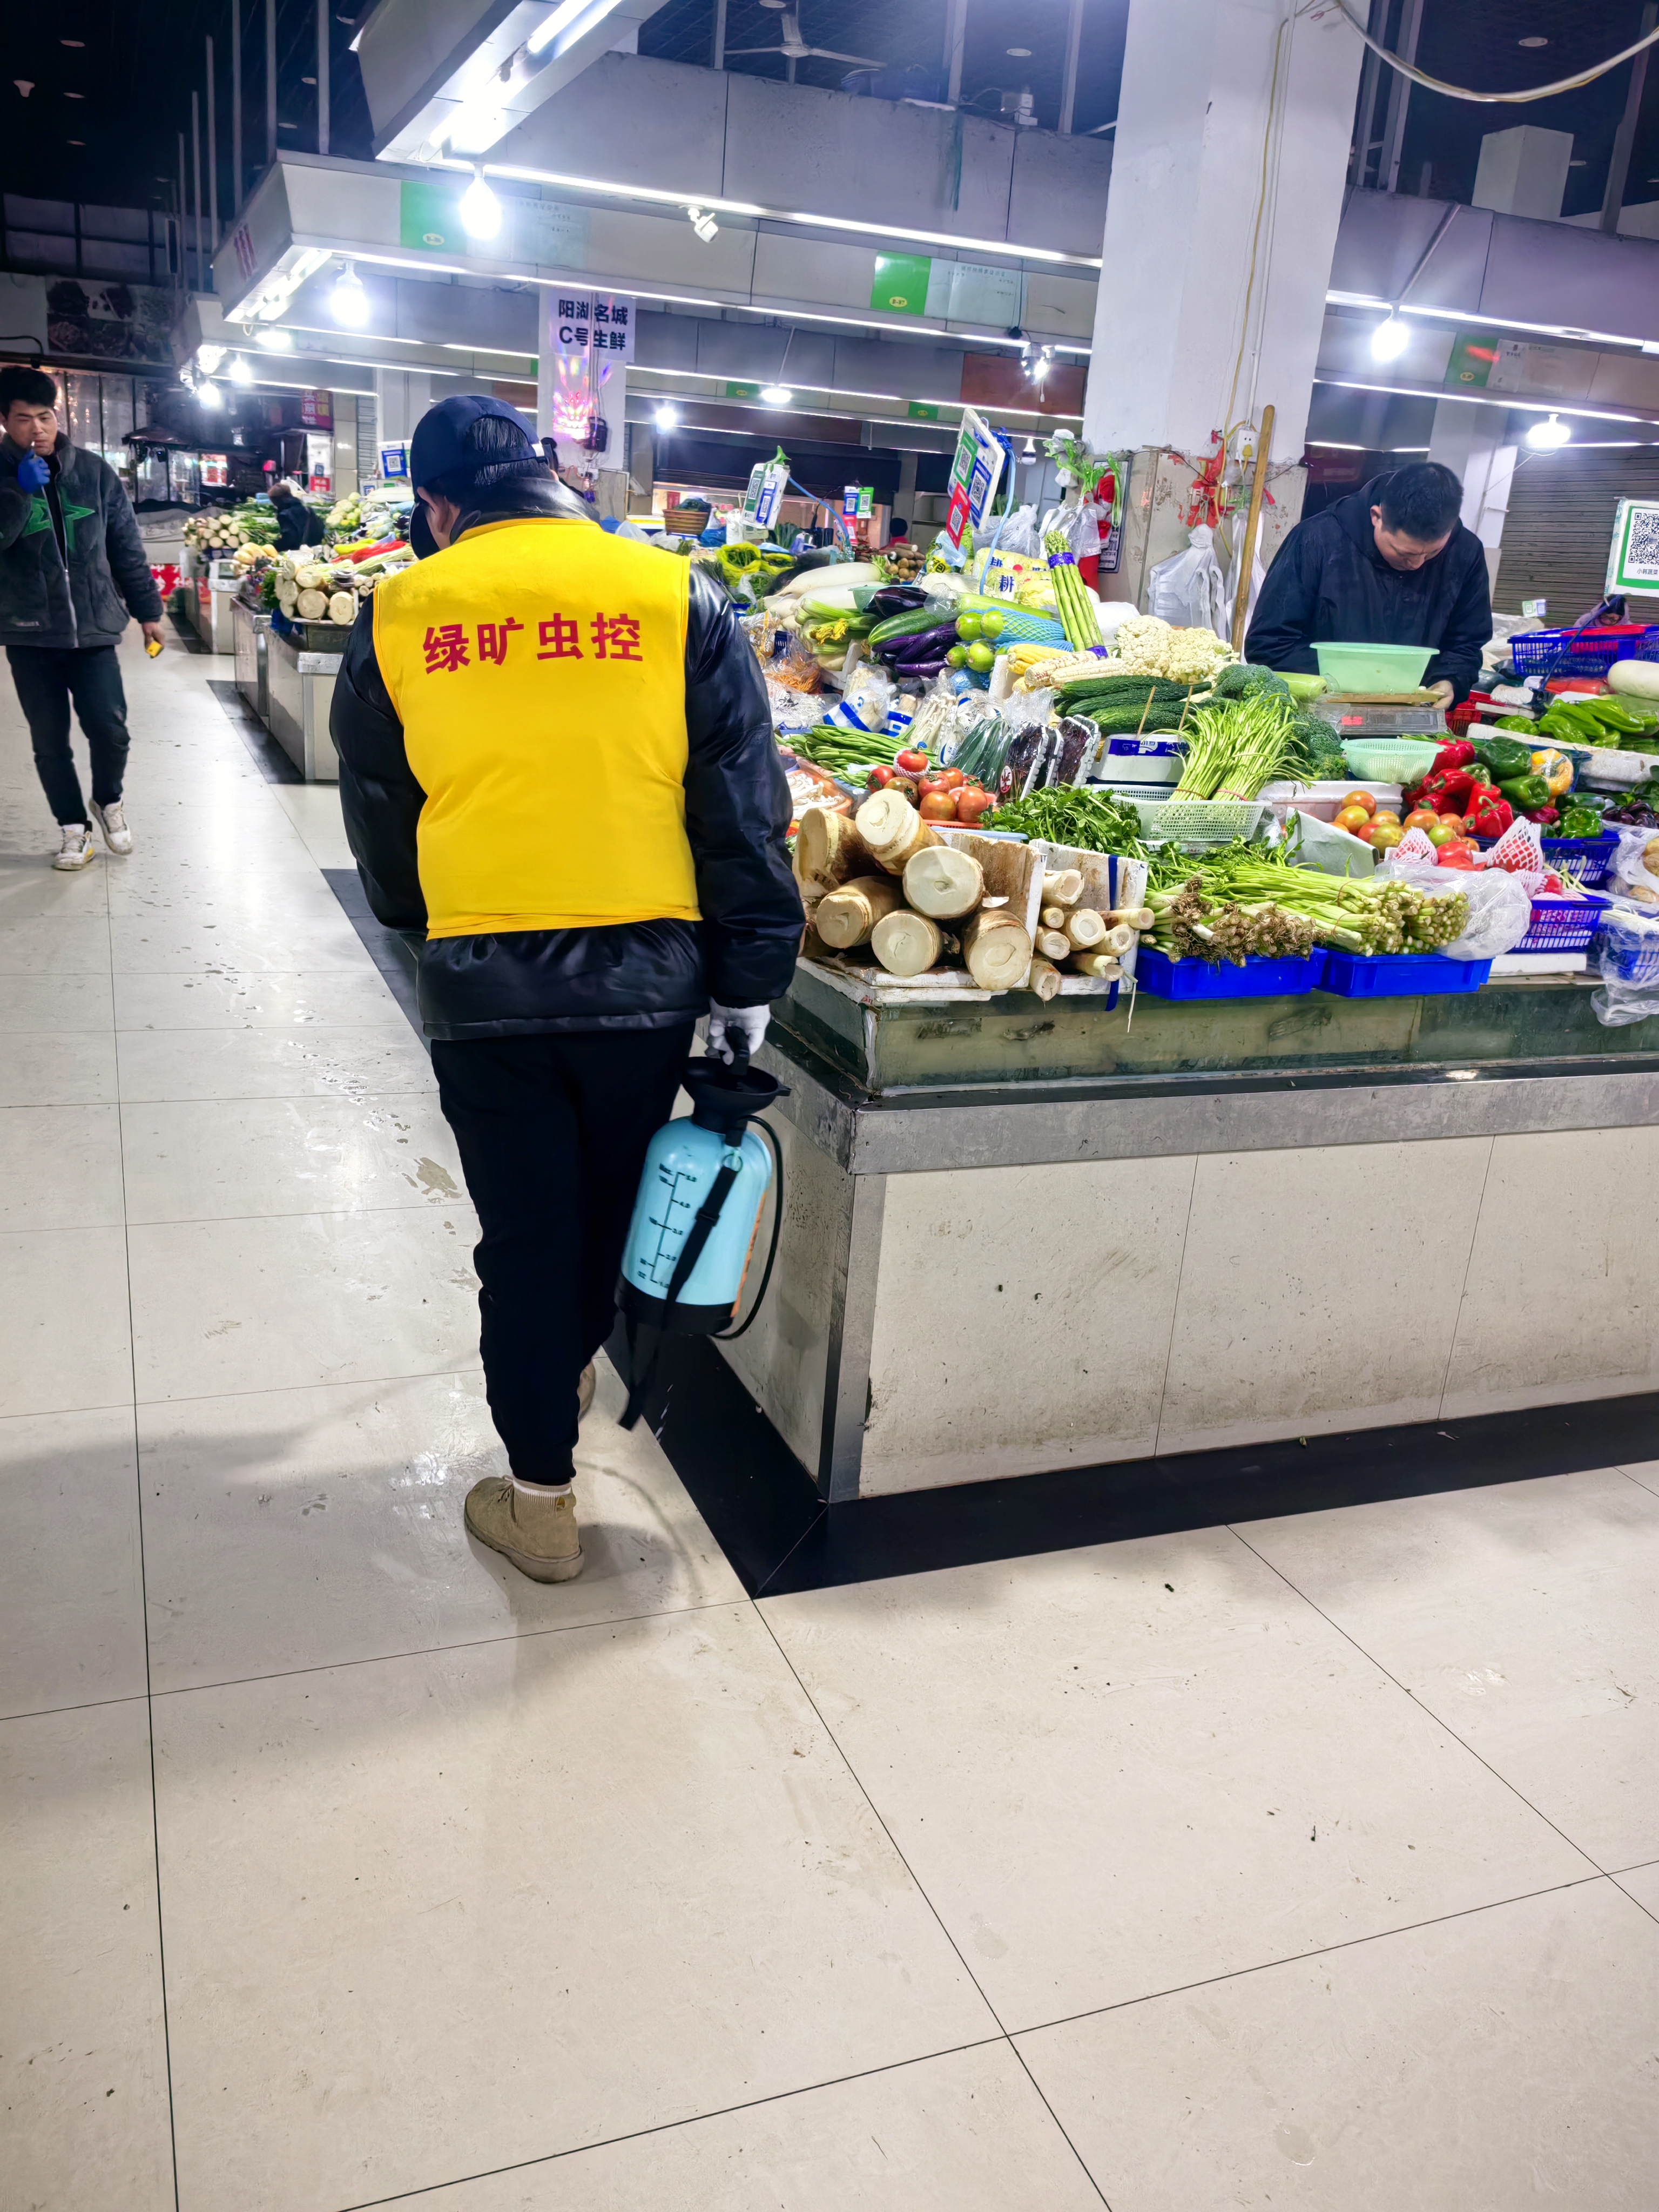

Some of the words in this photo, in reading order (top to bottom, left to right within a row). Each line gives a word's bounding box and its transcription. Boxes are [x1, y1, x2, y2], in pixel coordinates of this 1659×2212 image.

[559, 299, 628, 325] 阳湖名城
[559, 326, 626, 350] C号生鲜
[423, 612, 643, 674] 绿旷虫控
